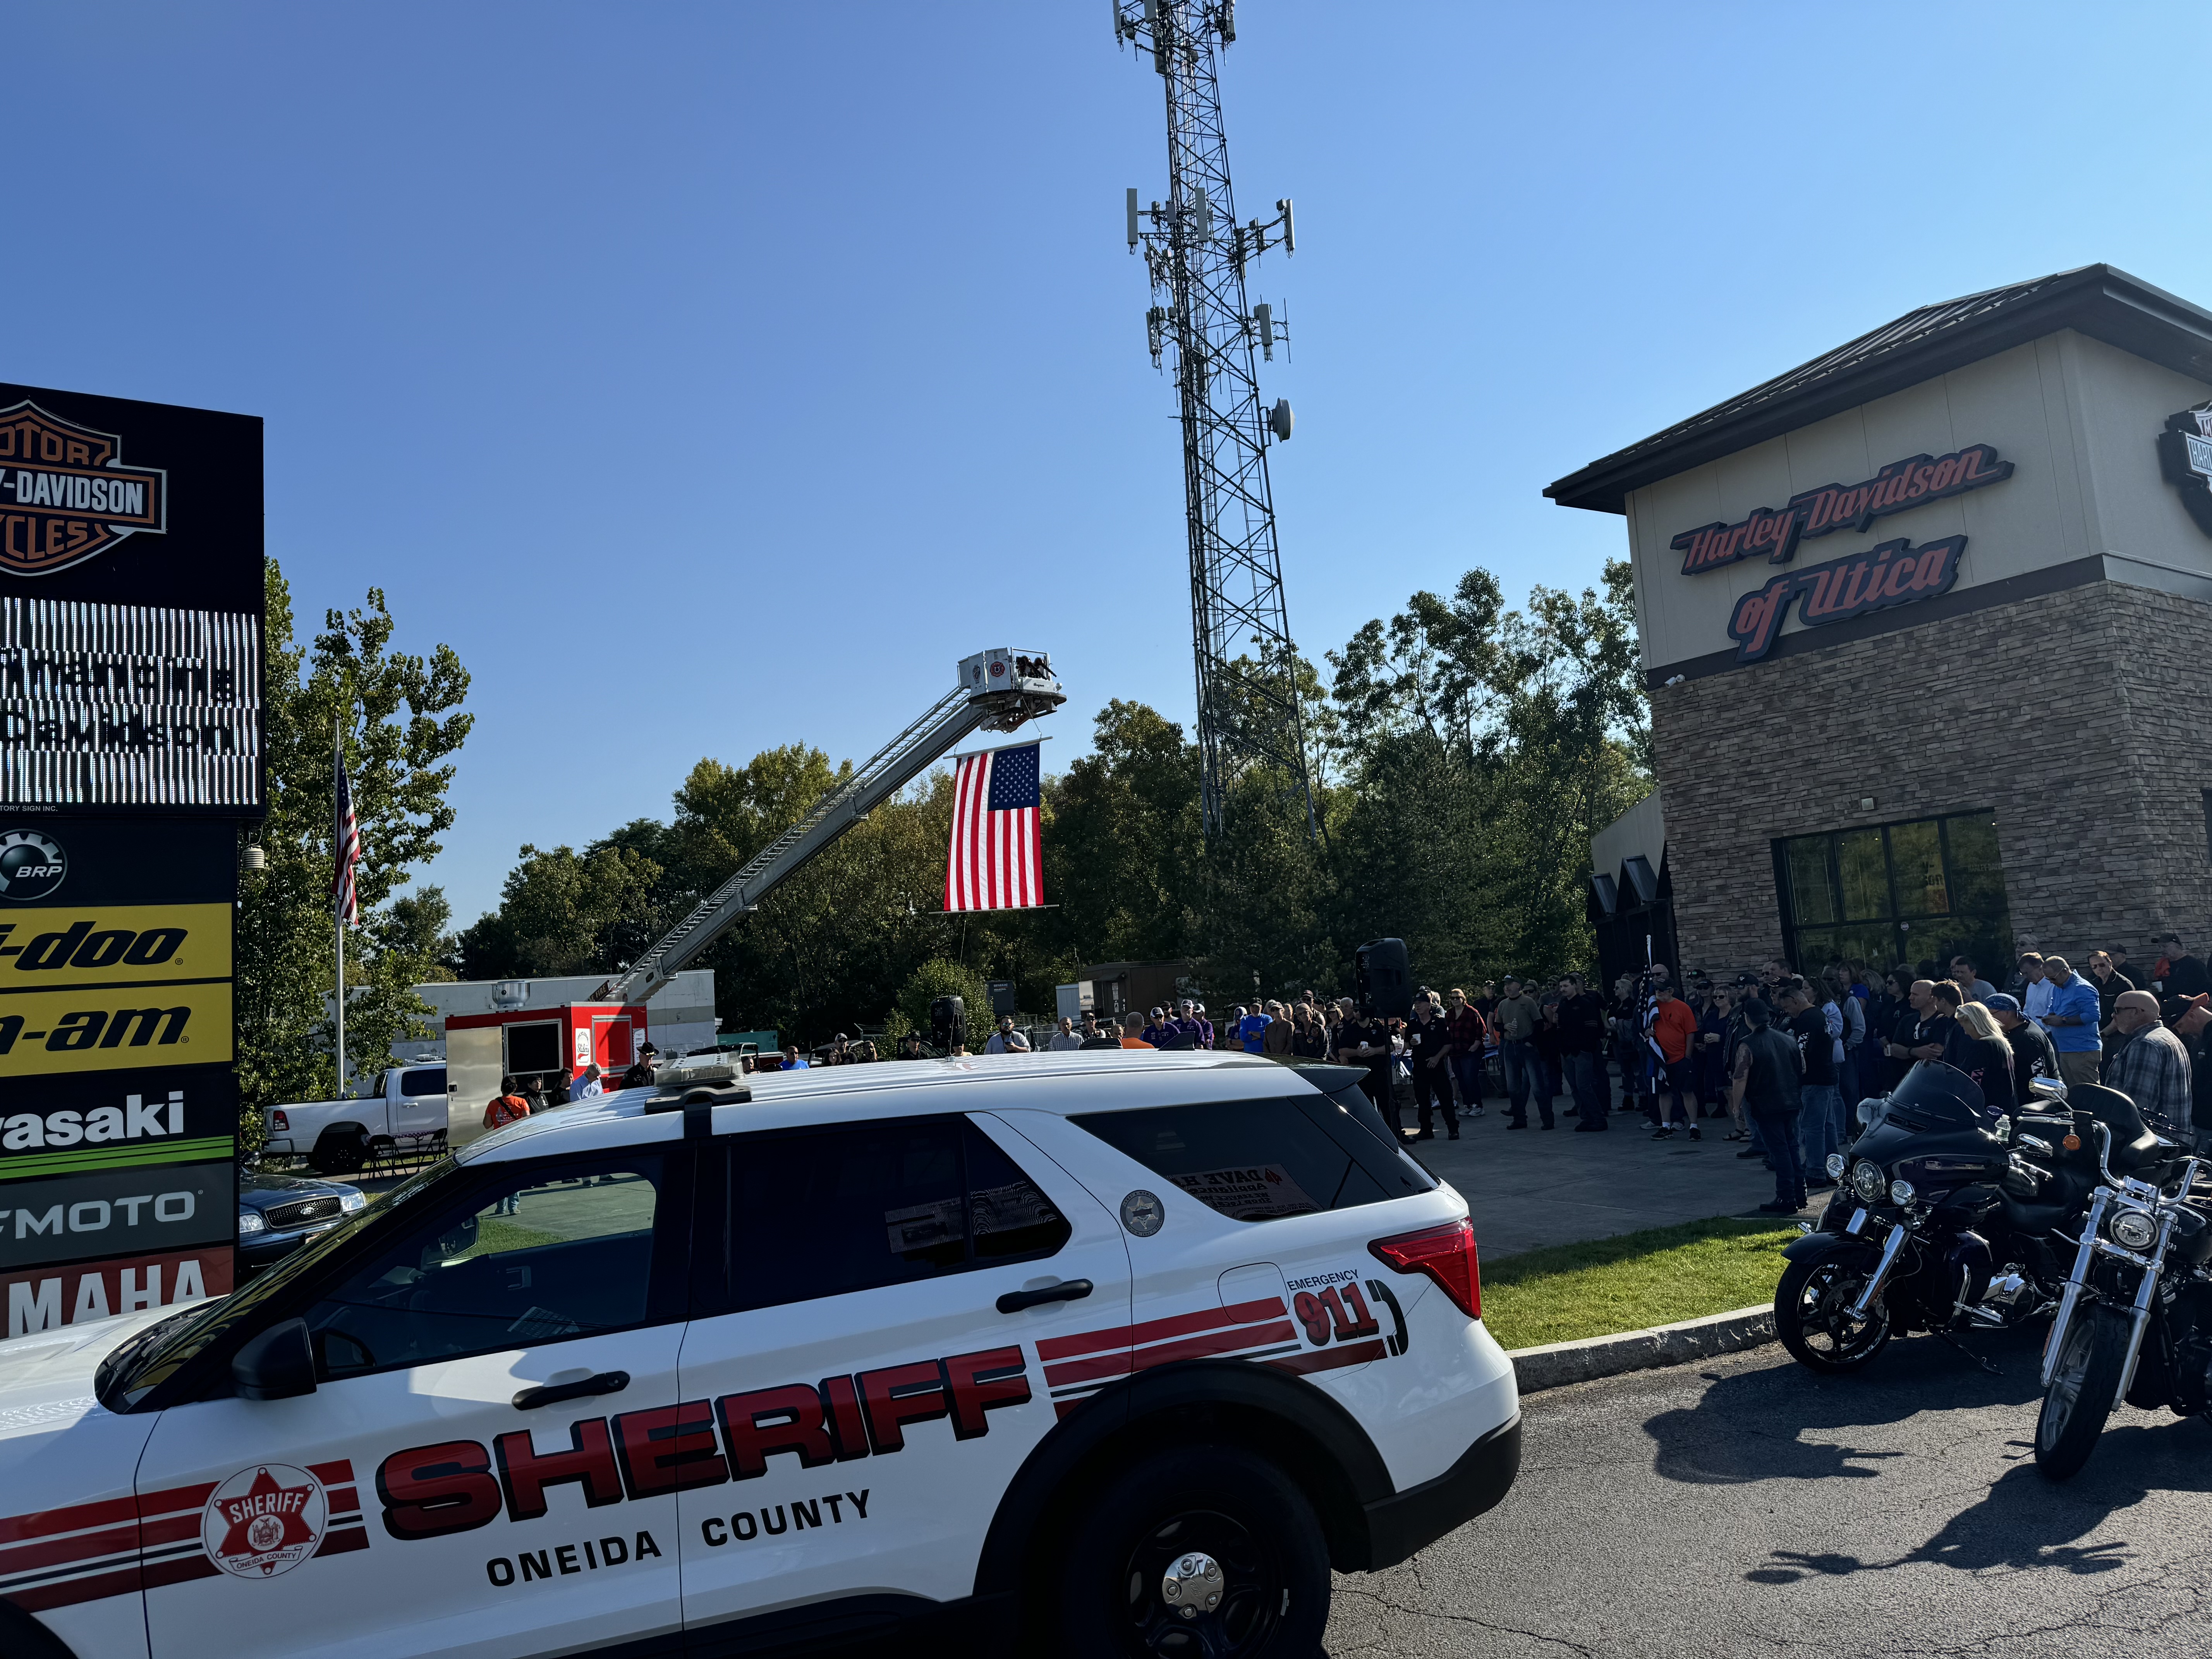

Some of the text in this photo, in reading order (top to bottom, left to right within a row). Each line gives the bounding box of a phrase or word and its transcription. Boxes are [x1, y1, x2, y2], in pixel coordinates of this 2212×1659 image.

[0, 469, 143, 515] -DAVIDSON
[1674, 449, 1999, 568] Harley-Davidson
[0, 514, 88, 560] CLES
[1736, 546, 1951, 653] of Utica
[15, 866, 62, 878] BRP
[595, 985, 607, 998] FIRE
[0, 1091, 184, 1150] asaki
[9, 1259, 206, 1338] MAHA
[1287, 1269, 1360, 1291] EMERGENCY
[1293, 1282, 1380, 1347] 911
[375, 1344, 1033, 1541] SHERIFF
[229, 1492, 304, 1524] SHERIFF
[237, 1556, 264, 1569] ONEIDA
[486, 1488, 870, 1587] ONEIDA COUNTY
